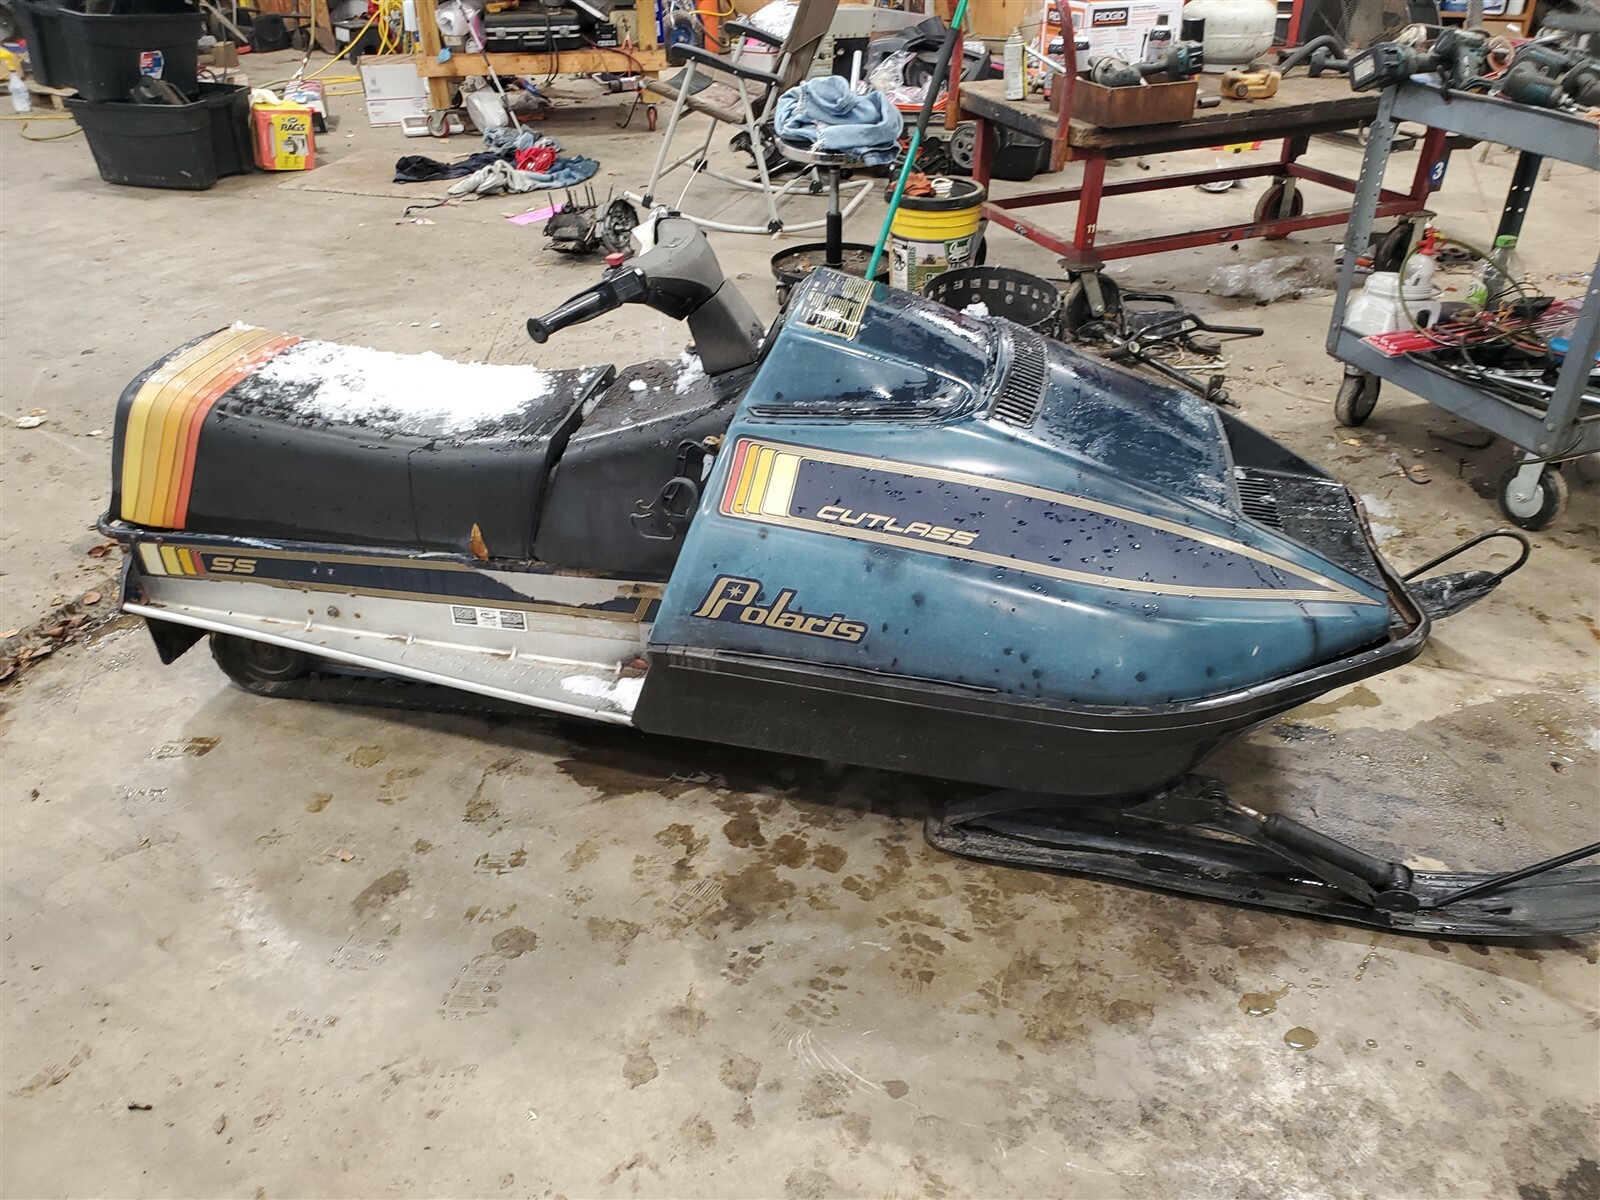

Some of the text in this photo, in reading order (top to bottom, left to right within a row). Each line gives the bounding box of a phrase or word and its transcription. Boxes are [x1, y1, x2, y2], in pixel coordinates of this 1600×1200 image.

[1094, 10, 1127, 22] RIDGID
[280, 123, 305, 131] RAGS
[1432, 161, 1445, 180] 3
[1087, 223, 1096, 234] 11
[816, 505, 980, 546] CUTLASS
[210, 556, 257, 574] SS
[692, 575, 868, 644] Polaris
